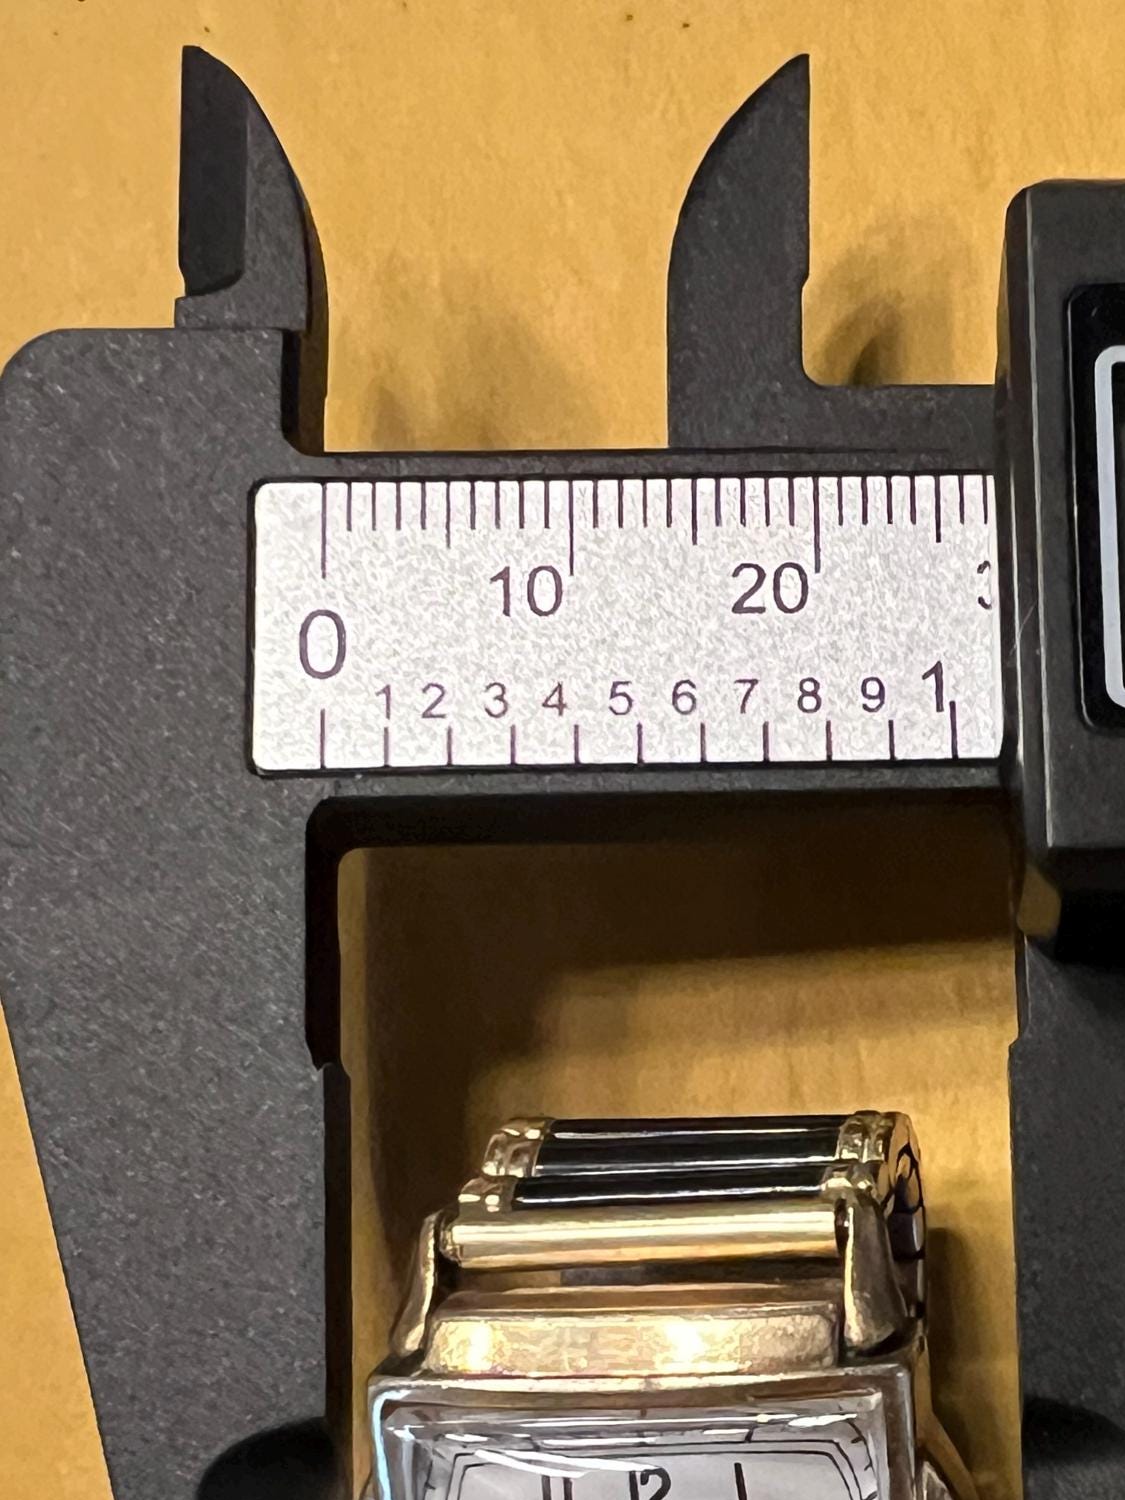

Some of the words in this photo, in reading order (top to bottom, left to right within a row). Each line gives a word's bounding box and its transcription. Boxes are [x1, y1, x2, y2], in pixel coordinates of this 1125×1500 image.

[490, 565, 564, 617] 10
[731, 562, 809, 615] 20
[299, 608, 347, 680] 0
[374, 683, 392, 720] 1
[421, 682, 447, 719] 2
[484, 681, 509, 718] 3
[541, 680, 568, 717] 4
[608, 680, 634, 716] 5
[671, 679, 698, 716] 6
[734, 678, 759, 714] 7
[797, 676, 823, 713] 8
[860, 676, 886, 713] 9
[921, 660, 945, 712] 1
